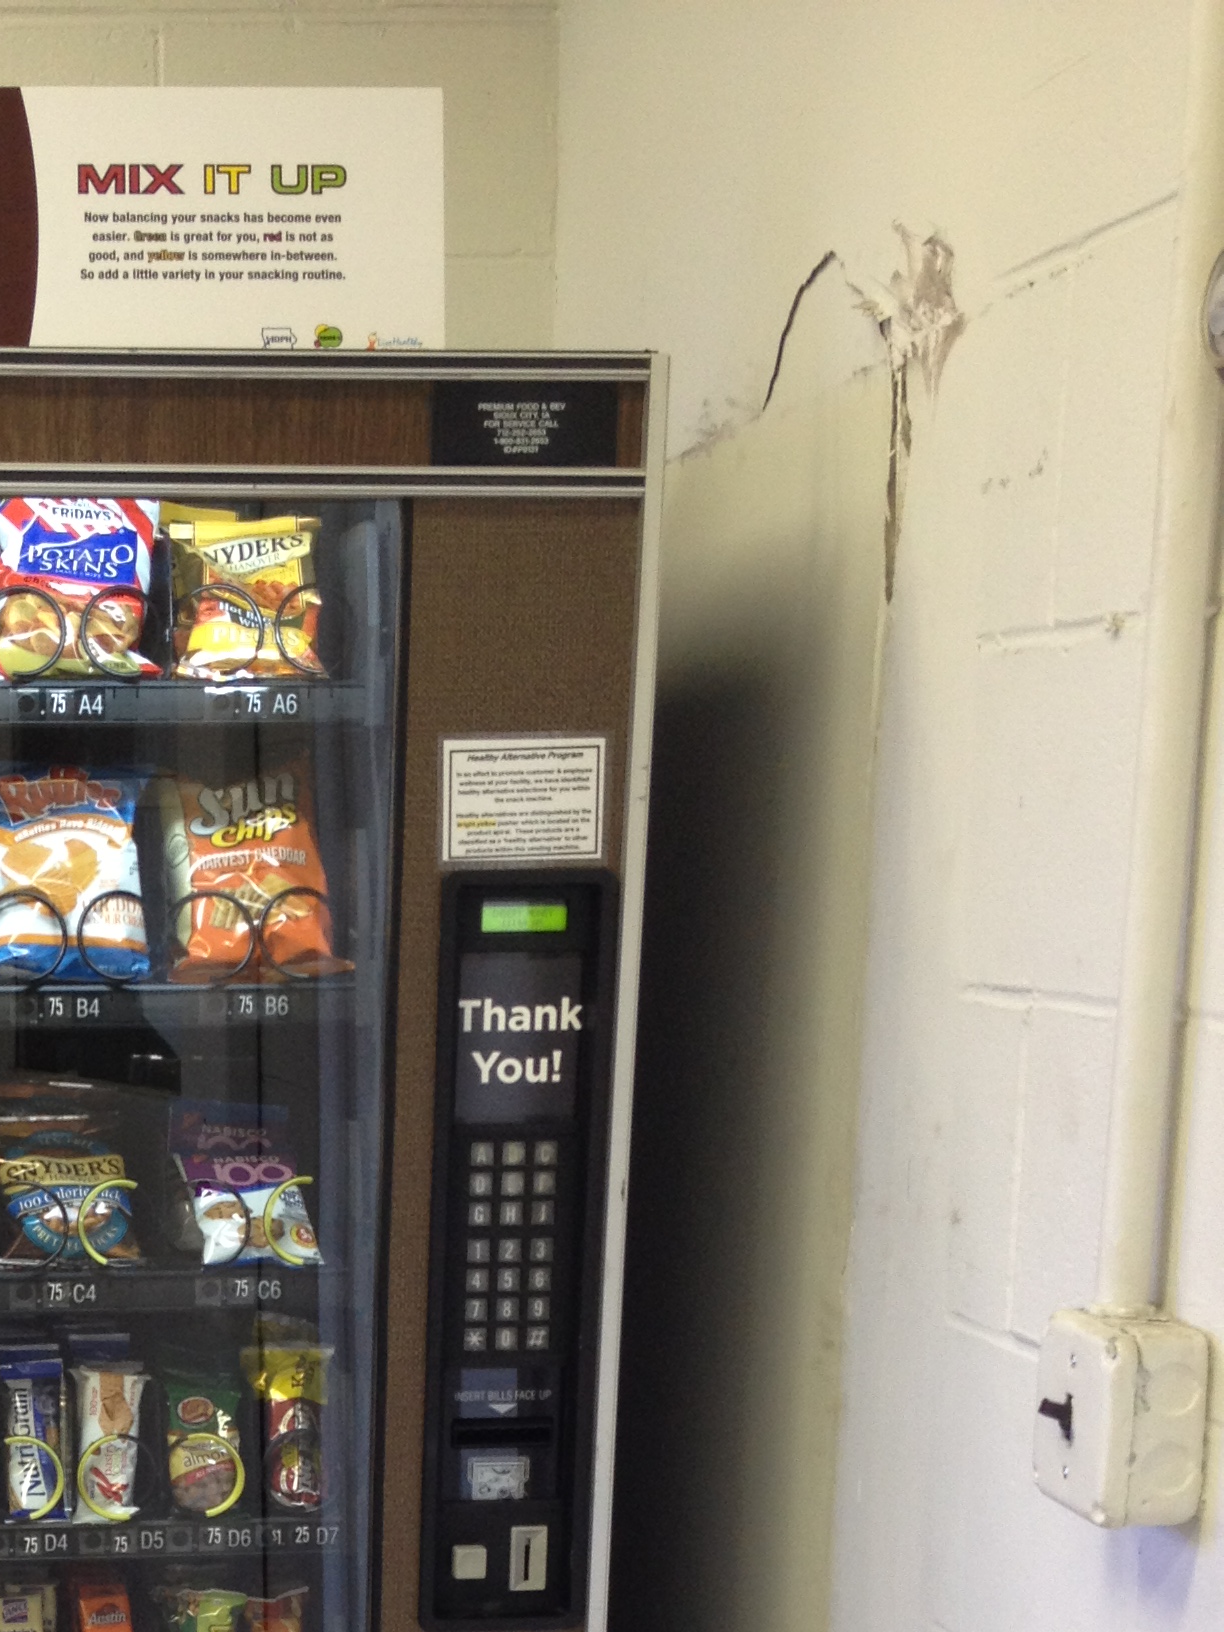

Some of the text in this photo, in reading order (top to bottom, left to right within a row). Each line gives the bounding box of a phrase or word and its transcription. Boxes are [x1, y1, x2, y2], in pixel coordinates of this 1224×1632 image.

[78, 163, 345, 195] MIX IT UP
[83, 211, 342, 226] Now balancing your snacks has become even
[91, 230, 131, 242] easier.
[169, 230, 181, 242] is
[183, 230, 214, 245] great
[216, 230, 233, 242] for
[235, 232, 260, 245] you,
[285, 230, 296, 243] is
[298, 231, 318, 243] not
[320, 232, 334, 243] as
[88, 249, 120, 264] good,
[123, 249, 145, 261] and
[187, 249, 199, 261] is
[201, 249, 268, 262] somewhere
[270, 249, 338, 262] in-between.
[80, 267, 346, 283] So add a little variety in your snacking routine.
[478, 402, 540, 411] PREMIUM FOOD
[483, 420, 500, 429] FOR
[503, 420, 536, 429] SERVICE
[28, 544, 134, 564] POTATO
[39, 558, 118, 578] SKINS
[78, 693, 104, 715] A4
[273, 693, 298, 715] A6
[466, 751, 584, 763] Healthy Alternative Program
[190, 773, 294, 836] Sun
[76, 998, 101, 1018] B4
[265, 995, 289, 1016] B6
[458, 996, 583, 1033] Thank
[471, 1049, 562, 1084] You!
[73, 1283, 97, 1303] C4
[258, 1280, 282, 1299] C6
[45, 1534, 68, 1552] D4
[141, 1531, 164, 1549] D5
[228, 1529, 252, 1548] D6
[317, 1528, 339, 1546] D7
[88, 1612, 126, 1626] Austin
